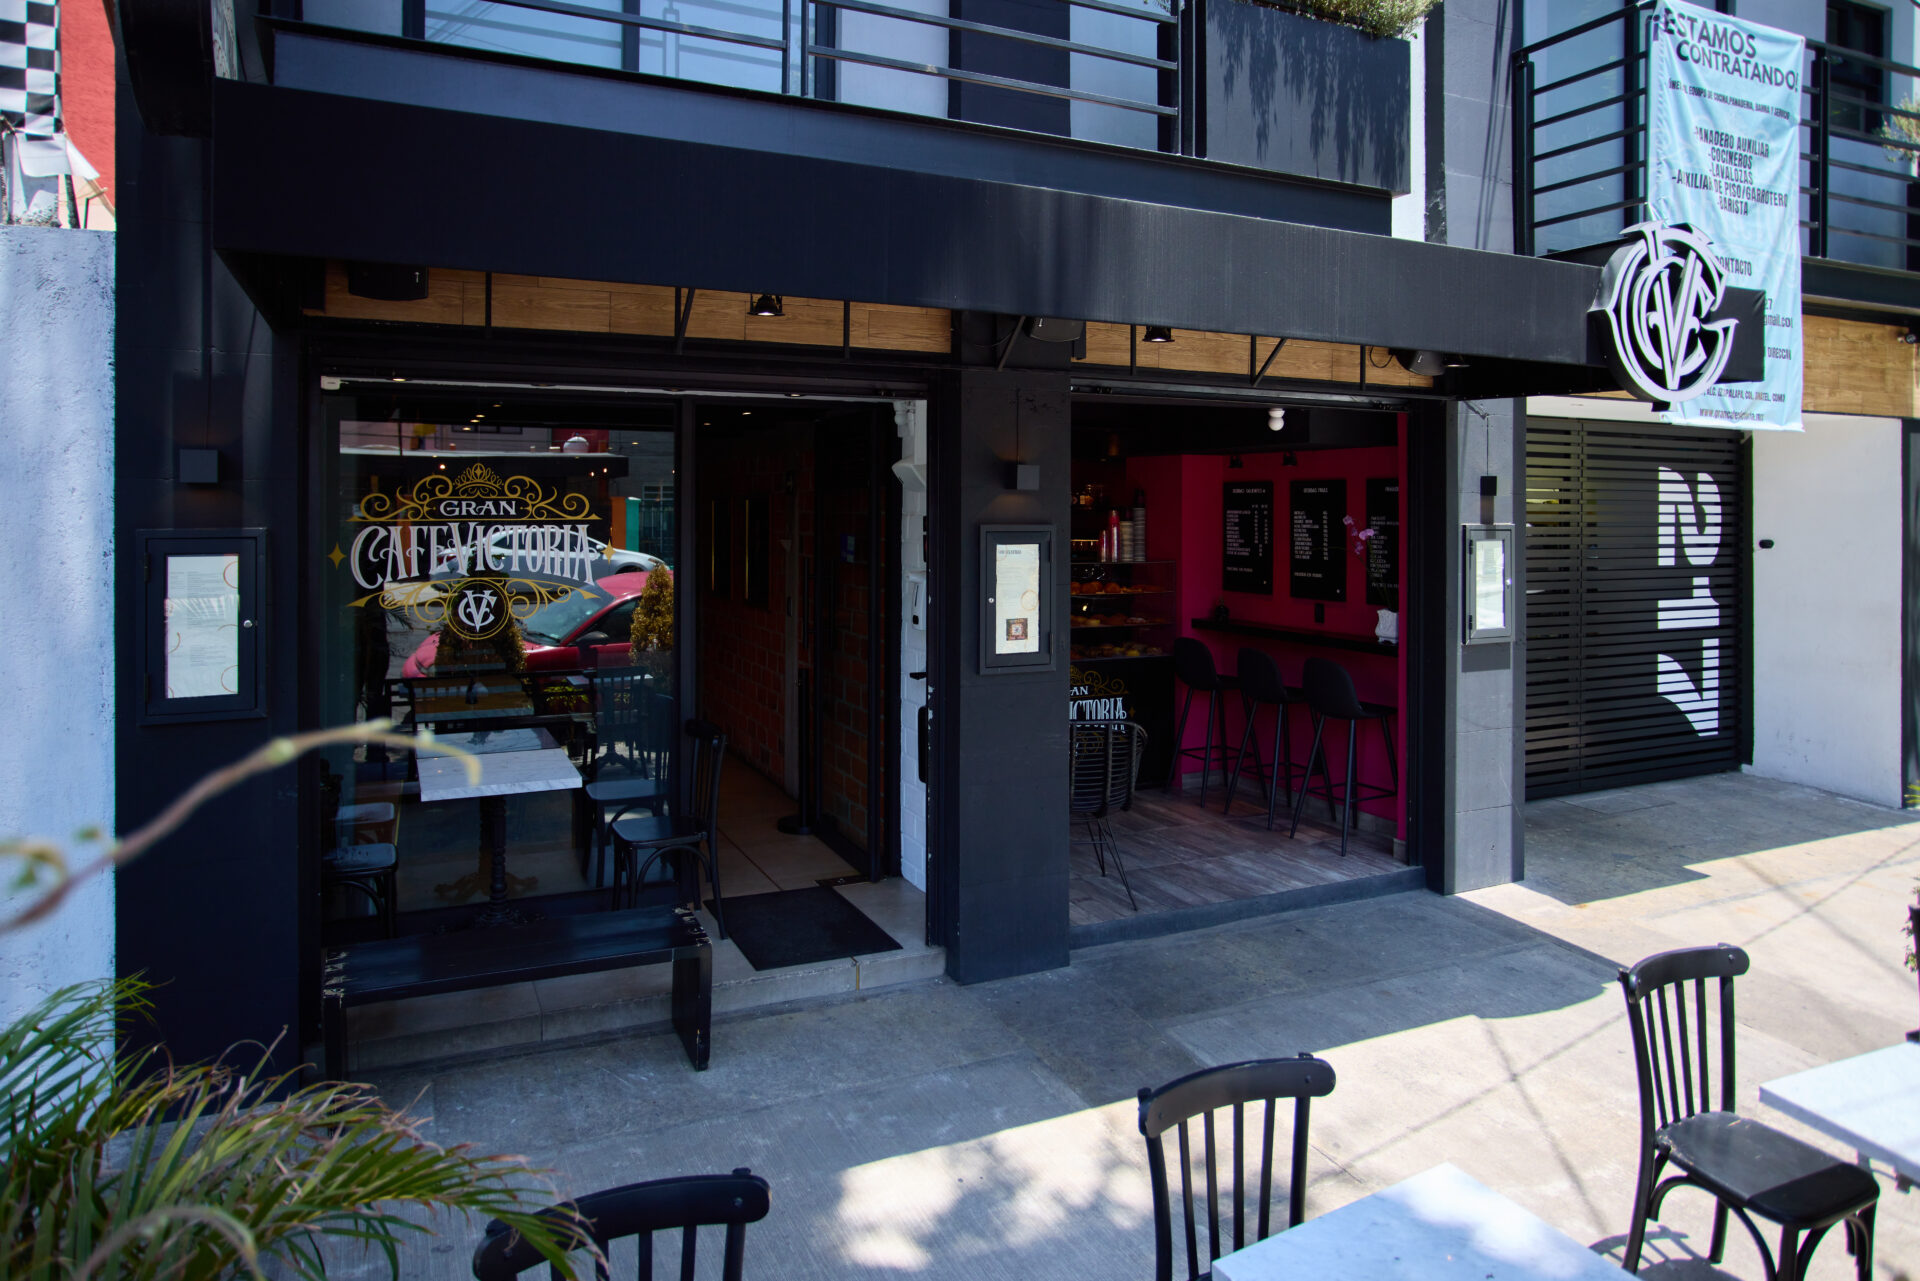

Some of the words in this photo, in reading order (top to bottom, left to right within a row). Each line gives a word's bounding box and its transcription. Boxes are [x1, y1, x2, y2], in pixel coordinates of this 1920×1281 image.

[1676, 39, 1799, 92] CONTRATANDO!
[1736, 136, 1770, 158] AUXILIAR
[1672, 169, 1713, 191] -AXILIAR
[440, 500, 517, 516] GRAN
